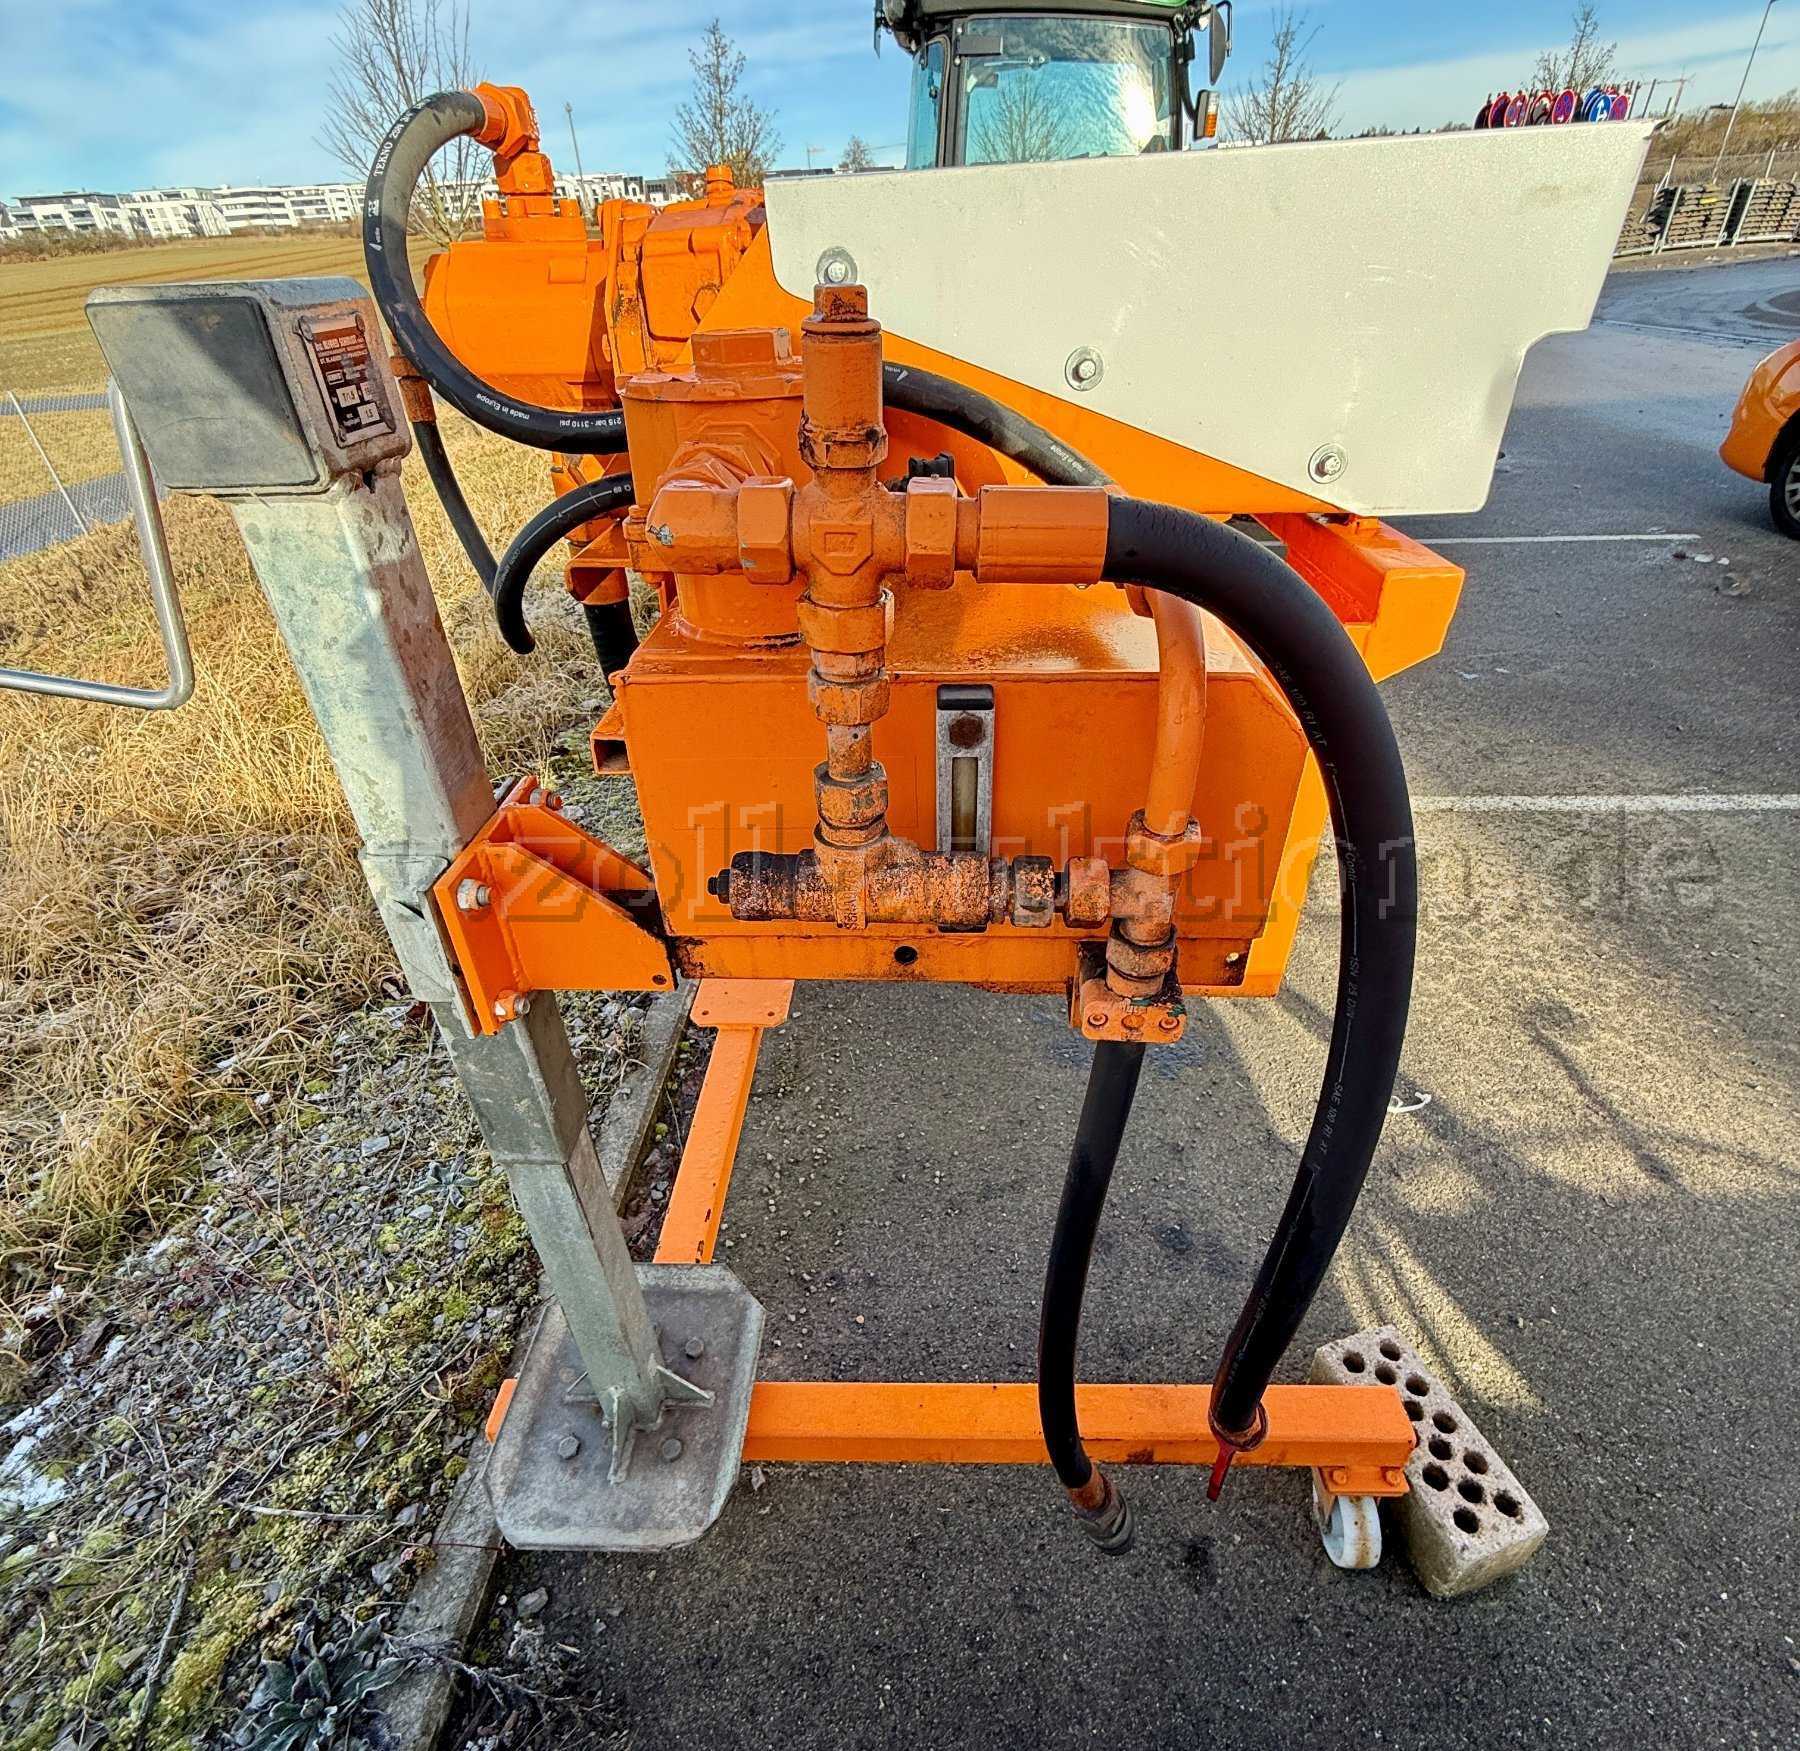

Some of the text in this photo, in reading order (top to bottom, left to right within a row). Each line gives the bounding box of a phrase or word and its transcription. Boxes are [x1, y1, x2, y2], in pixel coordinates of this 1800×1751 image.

[373, 142, 393, 177] TEKNO
[476, 393, 500, 411] Europe
[510, 409, 530, 420] made
[559, 419, 571, 428] psi
[571, 419, 590, 428] 3110
[595, 419, 608, 427] bar
[608, 417, 622, 426] 215
[1333, 1081, 1344, 1105] SAE
